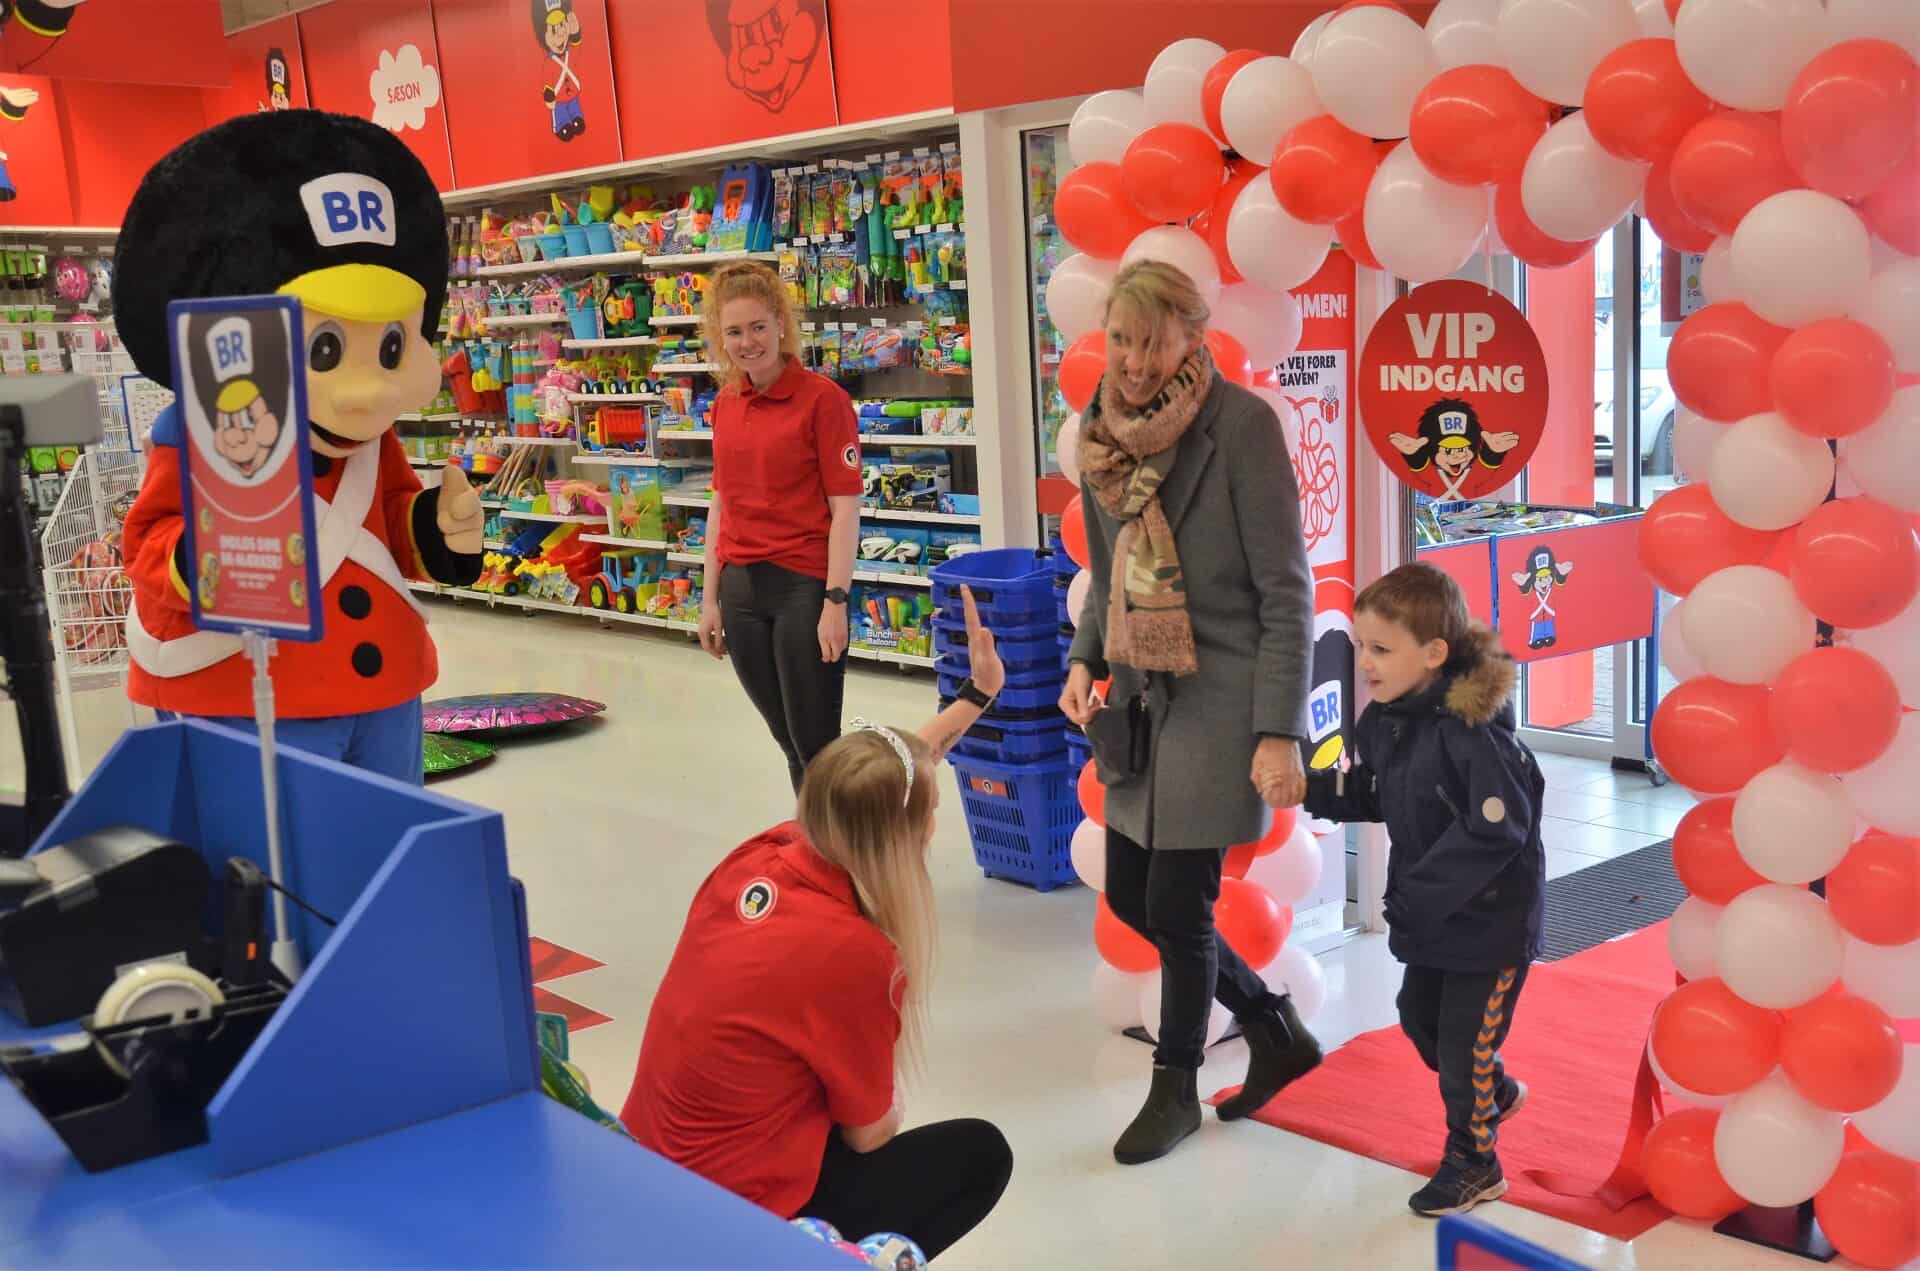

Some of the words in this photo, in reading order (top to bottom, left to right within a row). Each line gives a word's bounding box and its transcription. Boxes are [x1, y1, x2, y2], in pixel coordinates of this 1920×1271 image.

[388, 82, 421, 103] SÆSON
[321, 190, 387, 233] BR
[215, 331, 247, 369] BR
[1405, 313, 1496, 359] VIP
[1288, 356, 1304, 371] VEJ
[1307, 355, 1336, 369] FØRER
[1279, 372, 1319, 387] GAVEN?
[1380, 365, 1525, 393] INDGANG
[1443, 416, 1463, 431] BR
[1311, 691, 1339, 732] BR
